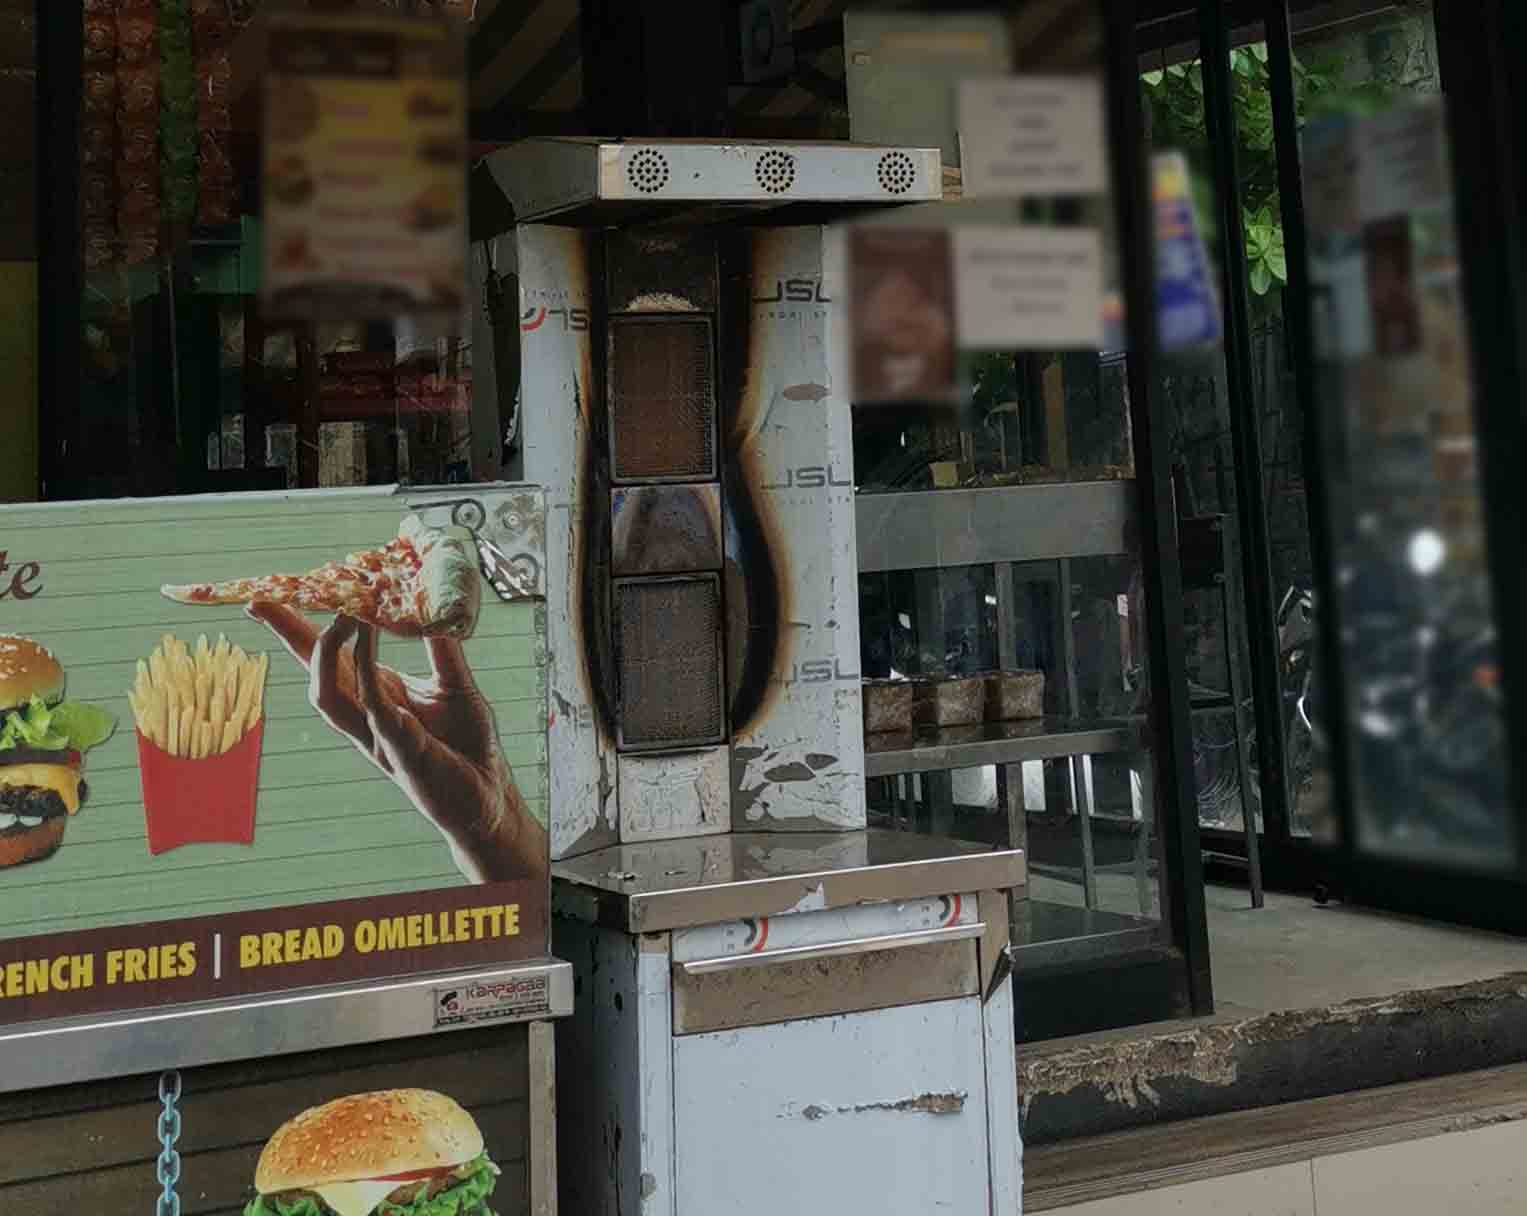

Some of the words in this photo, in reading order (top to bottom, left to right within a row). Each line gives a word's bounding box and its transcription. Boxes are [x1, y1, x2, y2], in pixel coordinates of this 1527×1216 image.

[106, 941, 197, 984] FRIES
[240, 924, 345, 968] BREAD
[354, 903, 520, 953] OMELLETTE
